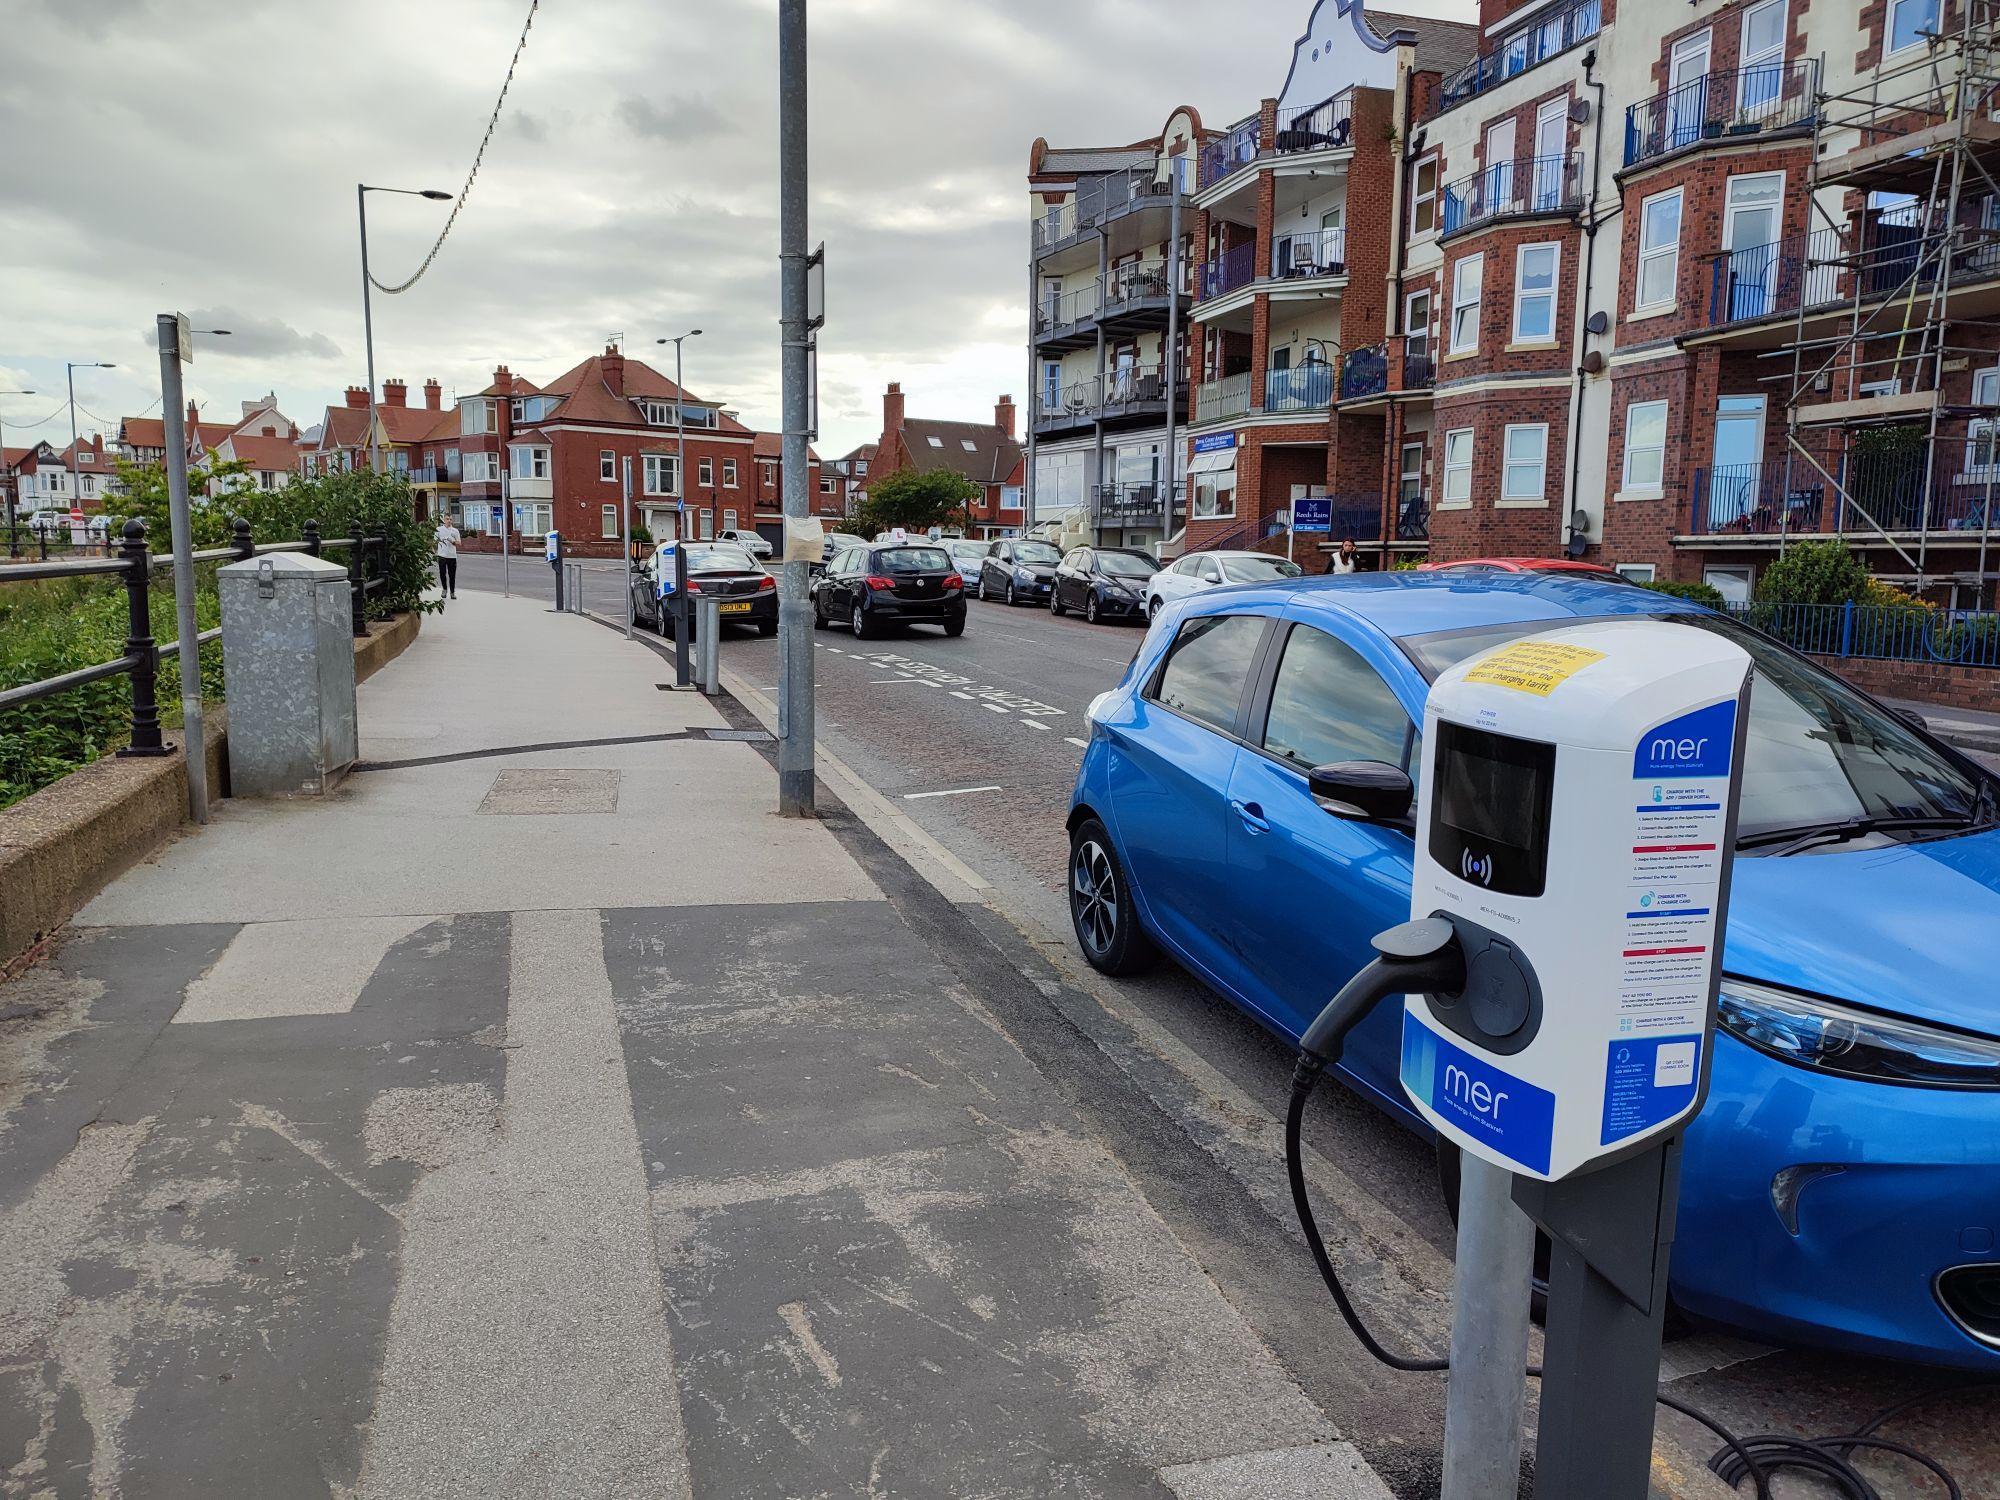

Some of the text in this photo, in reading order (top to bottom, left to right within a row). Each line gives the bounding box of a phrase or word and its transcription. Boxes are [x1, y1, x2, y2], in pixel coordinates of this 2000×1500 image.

[1492, 672, 1525, 686] charging
[1651, 738, 1708, 761] mer
[1445, 1064, 1508, 1119] mer
